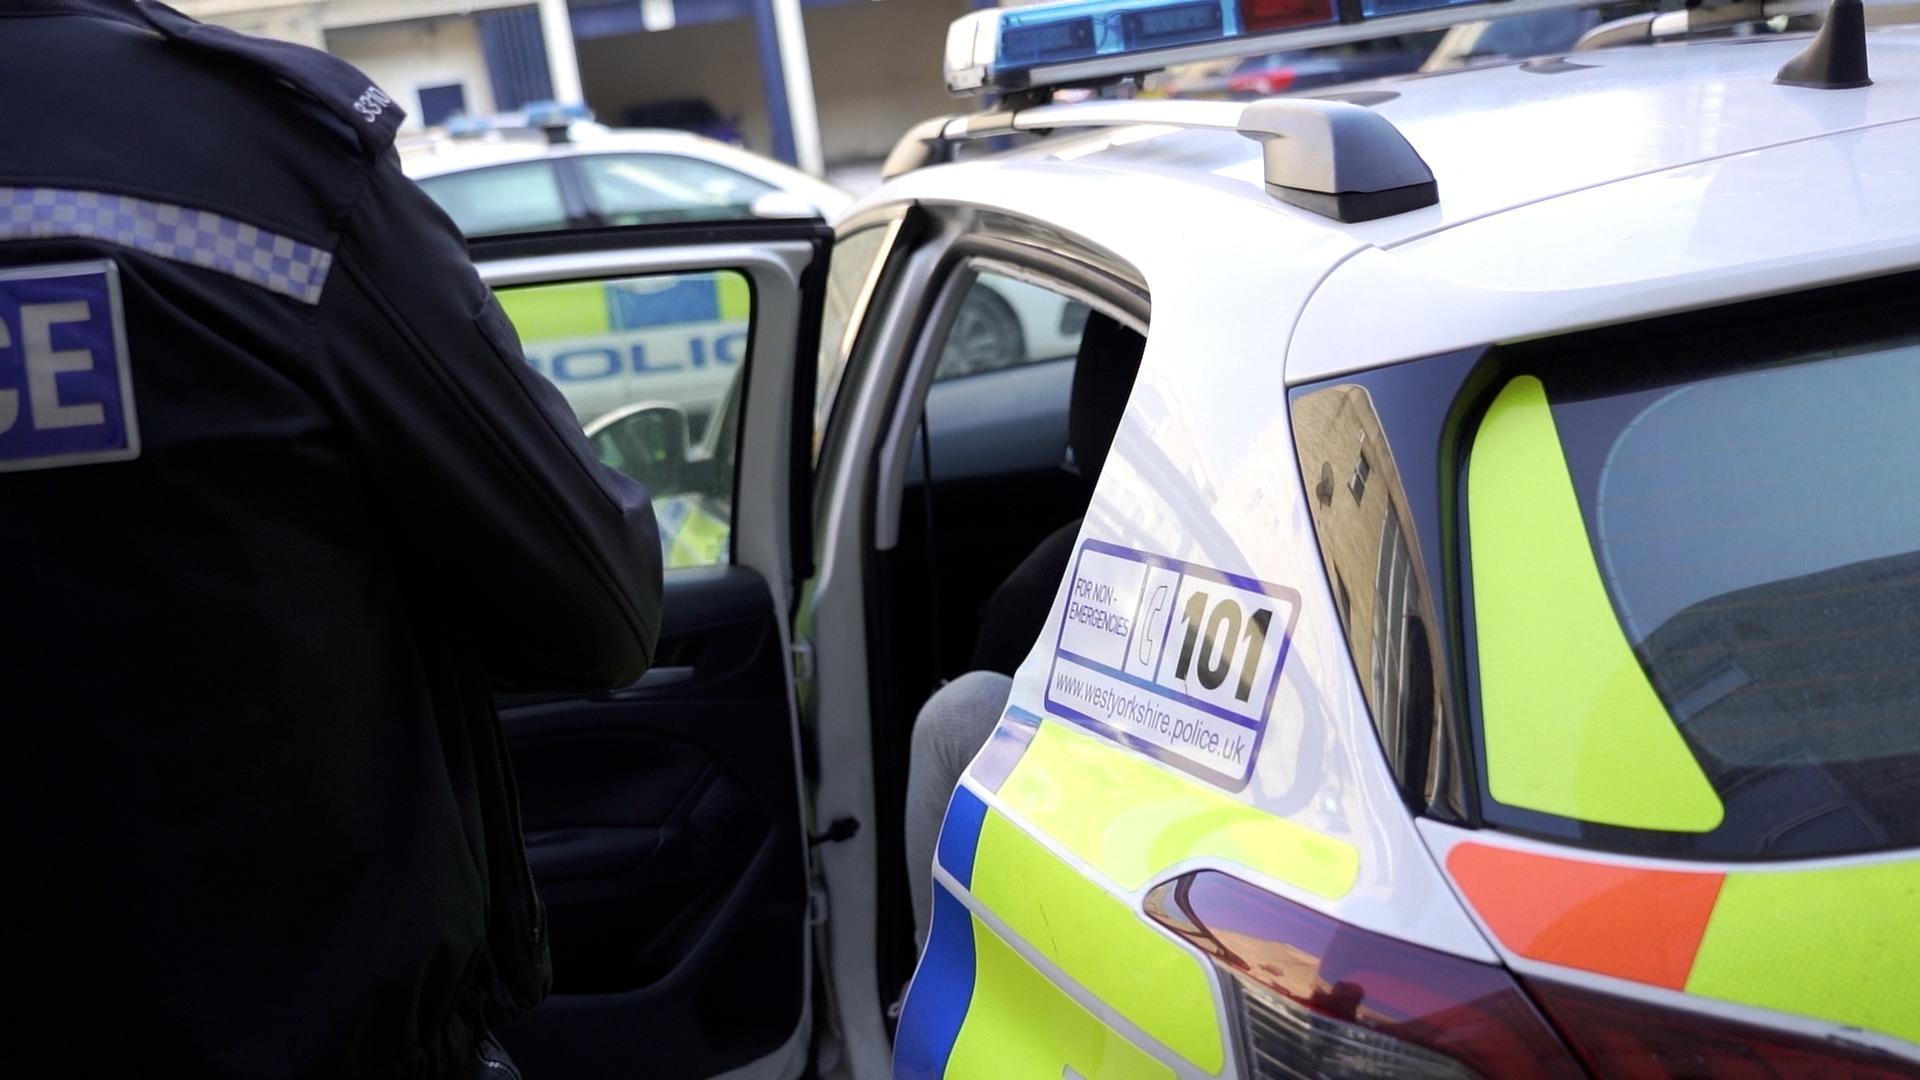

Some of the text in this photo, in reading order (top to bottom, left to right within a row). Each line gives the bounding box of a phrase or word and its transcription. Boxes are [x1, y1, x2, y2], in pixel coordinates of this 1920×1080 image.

[0, 301, 105, 434] E
[1069, 601, 1130, 637] EMERGENCIES
[1074, 577, 1093, 599] FOR
[1174, 590, 1273, 703] 101
[1056, 671, 1246, 765] www.westyorkshire.police.uk
